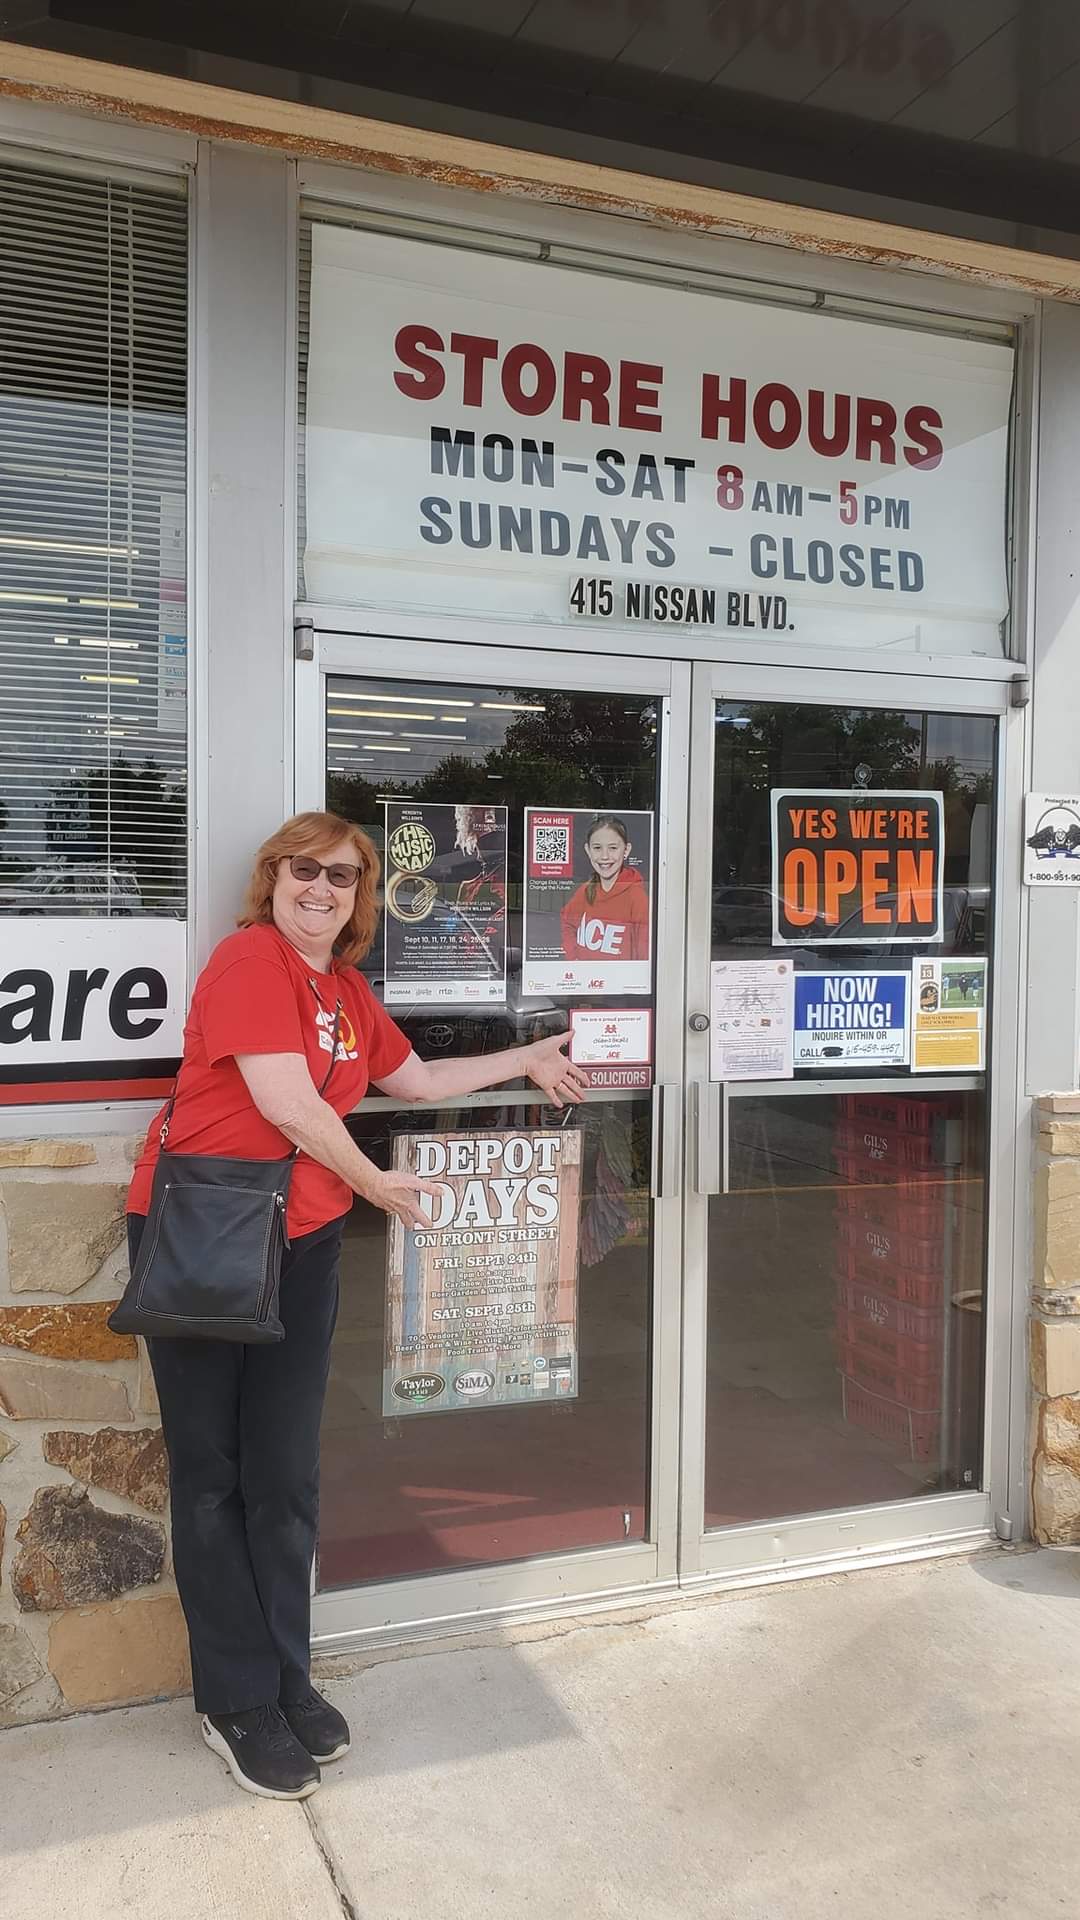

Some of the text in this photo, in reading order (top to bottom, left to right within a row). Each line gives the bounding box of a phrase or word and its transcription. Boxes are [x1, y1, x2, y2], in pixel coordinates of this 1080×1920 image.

[393, 325, 944, 471] STORE HOURS
[430, 427, 696, 504] MON-SAT
[419, 497, 676, 570] SUNDAYS
[750, 533, 925, 593] CLOSED
[569, 577, 796, 632] 415 NISSAN BLVD.
[789, 809, 929, 839] YES WE'RE
[394, 826, 430, 844] THE
[391, 839, 433, 858] MUSIC
[397, 852, 432, 870] MAN
[784, 848, 934, 926] OPEN
[824, 977, 878, 1002] NOW
[0, 967, 167, 1044] are
[807, 1003, 892, 1029] HIRING!
[812, 1031, 887, 1041] INQUIRE WITHIN OR
[800, 1048, 820, 1057] CALL
[591, 1071, 646, 1085] SOLICITORS
[864, 1134, 888, 1150] GIL'S
[416, 1137, 561, 1177] DEPOT
[413, 1176, 559, 1231] DAYS
[414, 1227, 557, 1248] ON FRONT STREET
[866, 1231, 890, 1250] GIL'S
[433, 1252, 537, 1270] FRI. SEPT. 24th
[461, 1280, 480, 1288] Show
[432, 1302, 536, 1321] SAT. SEPT. 25th
[863, 1295, 889, 1317] GIL'S
[428, 1332, 459, 1341] Vendors
[508, 1333, 533, 1342] Family
[401, 1375, 490, 1390] Taylor SiMA
